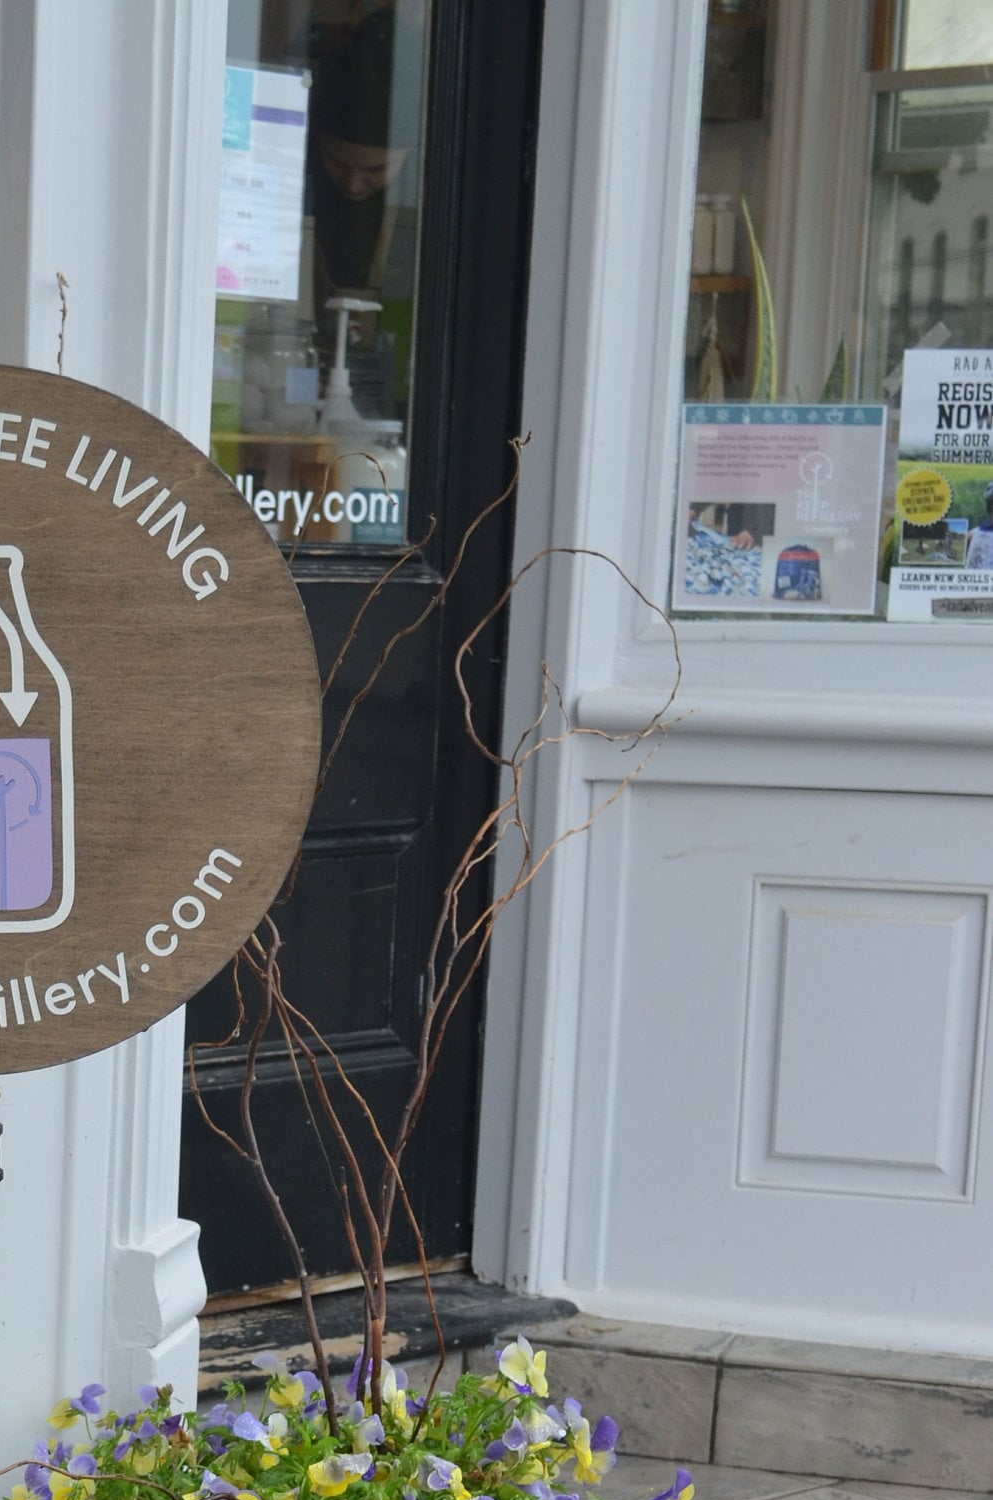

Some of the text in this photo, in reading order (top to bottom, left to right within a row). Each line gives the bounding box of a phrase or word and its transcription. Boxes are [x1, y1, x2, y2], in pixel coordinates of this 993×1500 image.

[954, 357, 979, 371] RAD
[934, 433, 990, 448] FOR OUR
[65, 436, 229, 601] LIVING
[901, 573, 989, 584] LEARN NEW SKILLS
